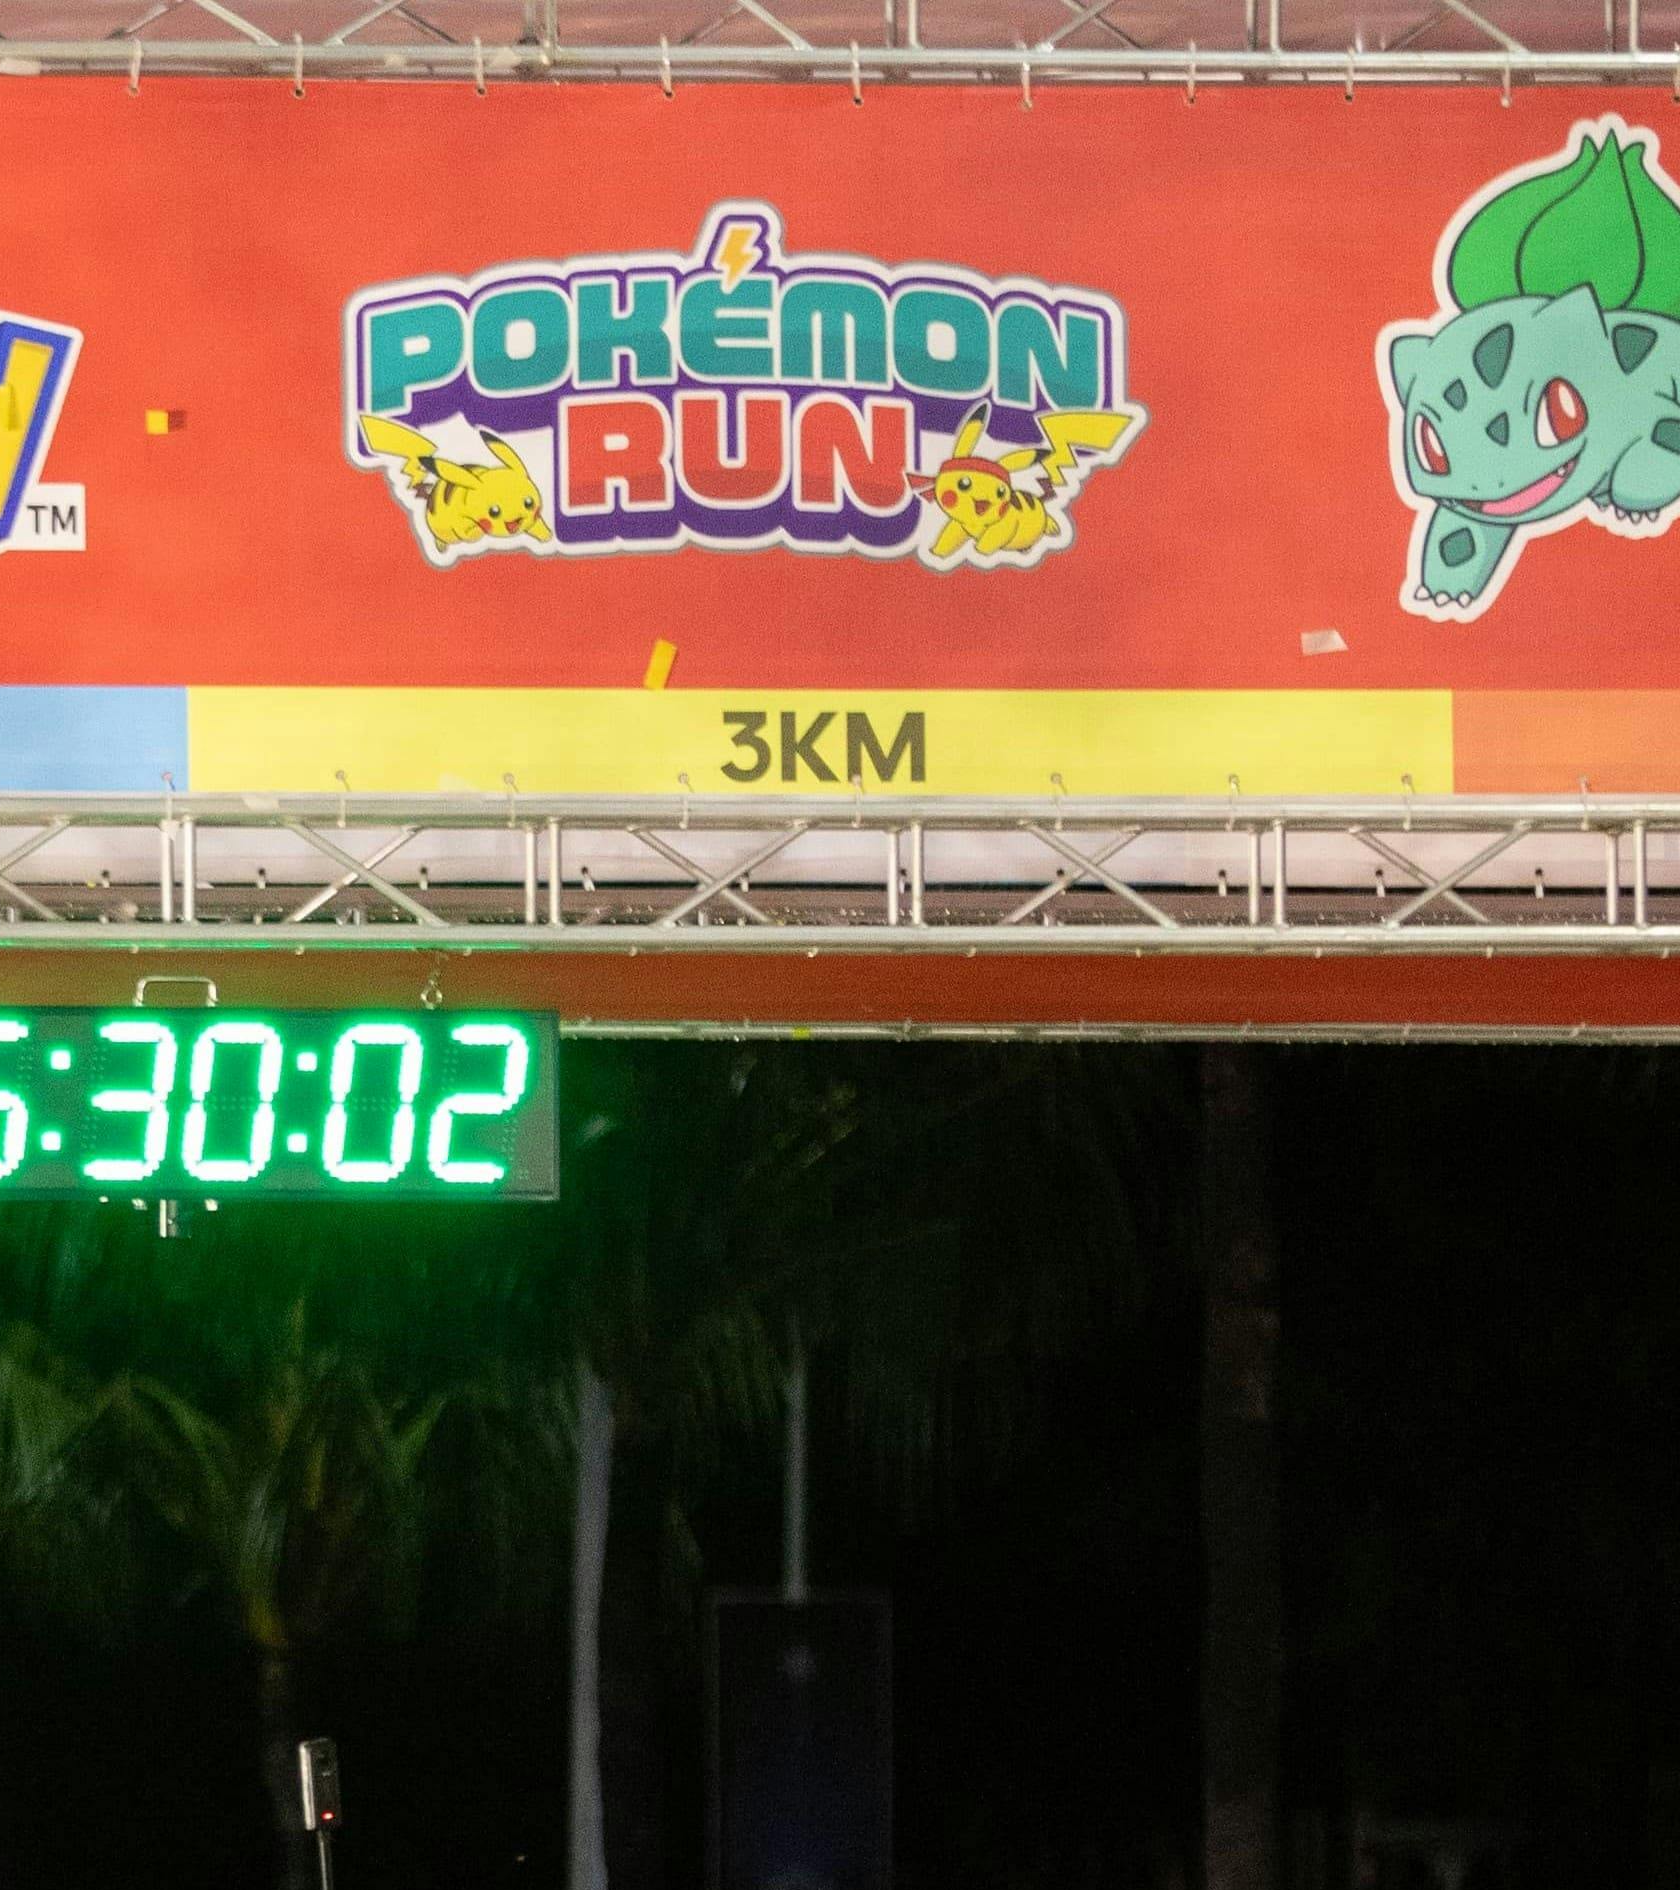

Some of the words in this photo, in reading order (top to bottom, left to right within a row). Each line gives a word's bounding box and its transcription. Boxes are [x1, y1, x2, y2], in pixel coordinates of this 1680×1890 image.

[367, 226, 1101, 414] POKÉMON
[565, 396, 913, 513] RUN
[720, 710, 927, 782] 3KM
